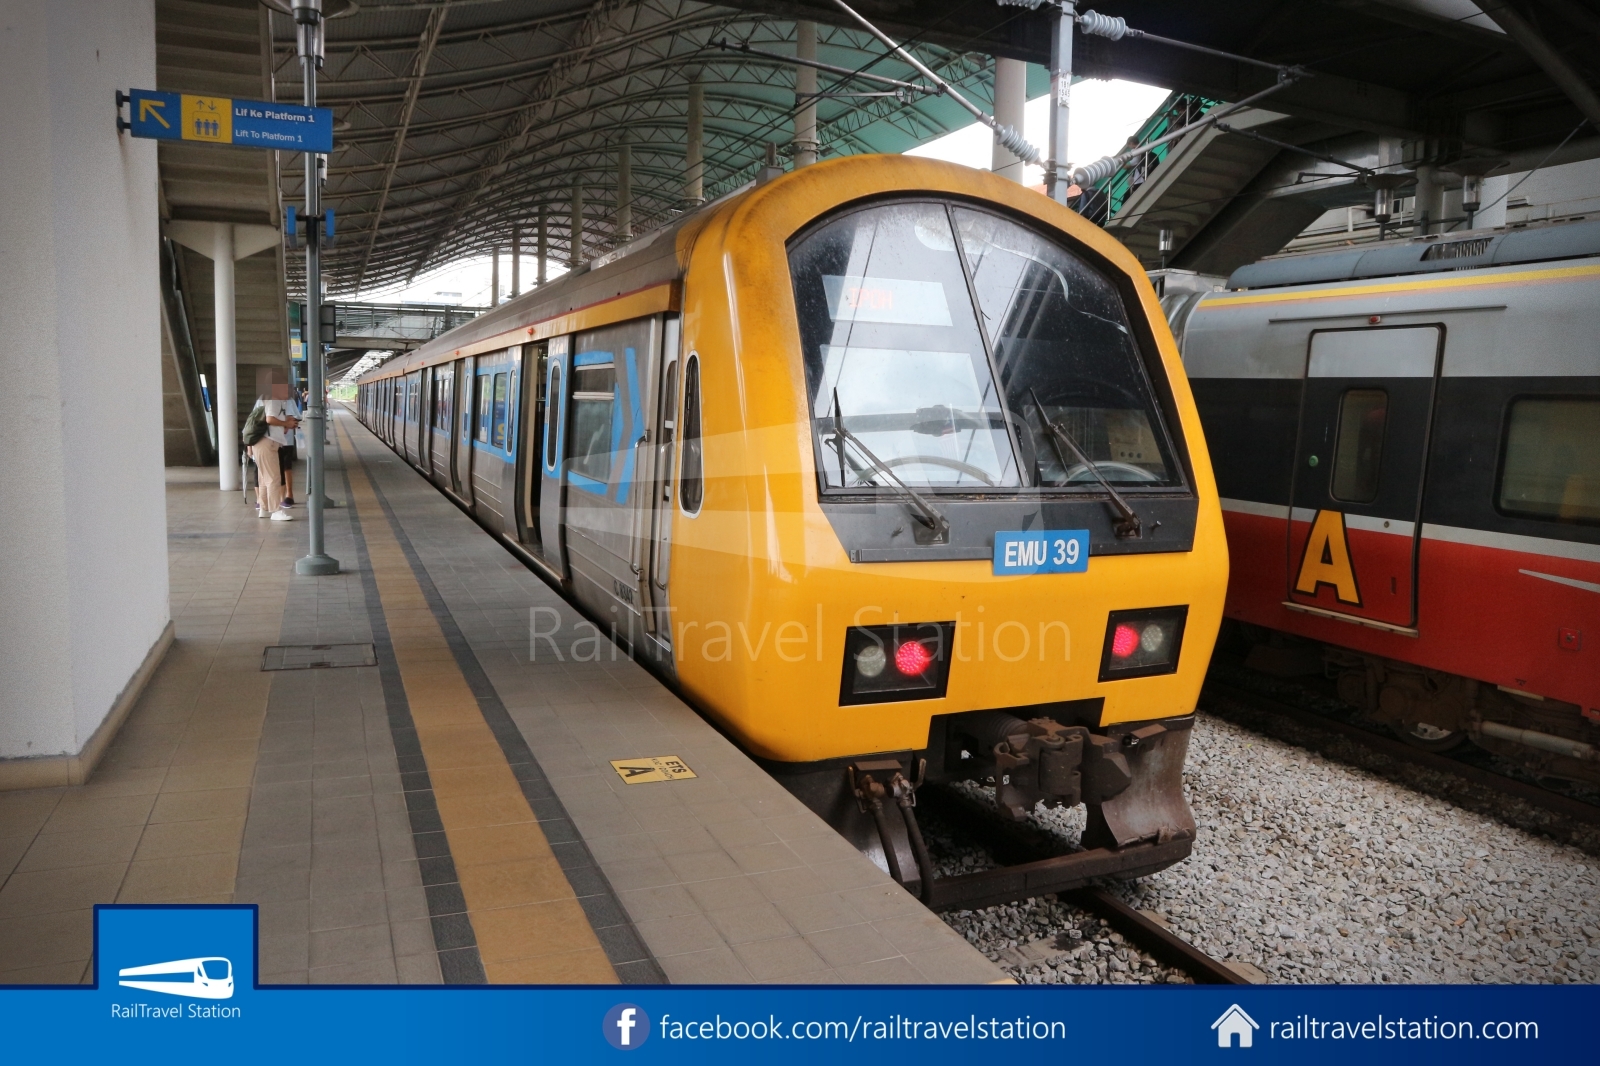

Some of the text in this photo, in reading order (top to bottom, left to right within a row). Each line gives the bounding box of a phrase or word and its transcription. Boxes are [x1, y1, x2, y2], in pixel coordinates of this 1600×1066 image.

[235, 108, 315, 123] Lif Ke Platform 1
[235, 129, 303, 143] Lift To Platform 1
[848, 287, 893, 310] IPOH
[1004, 538, 1080, 567] EMU 39
[1293, 508, 1363, 608] A
[618, 766, 656, 778] A
[665, 760, 687, 774] ETS
